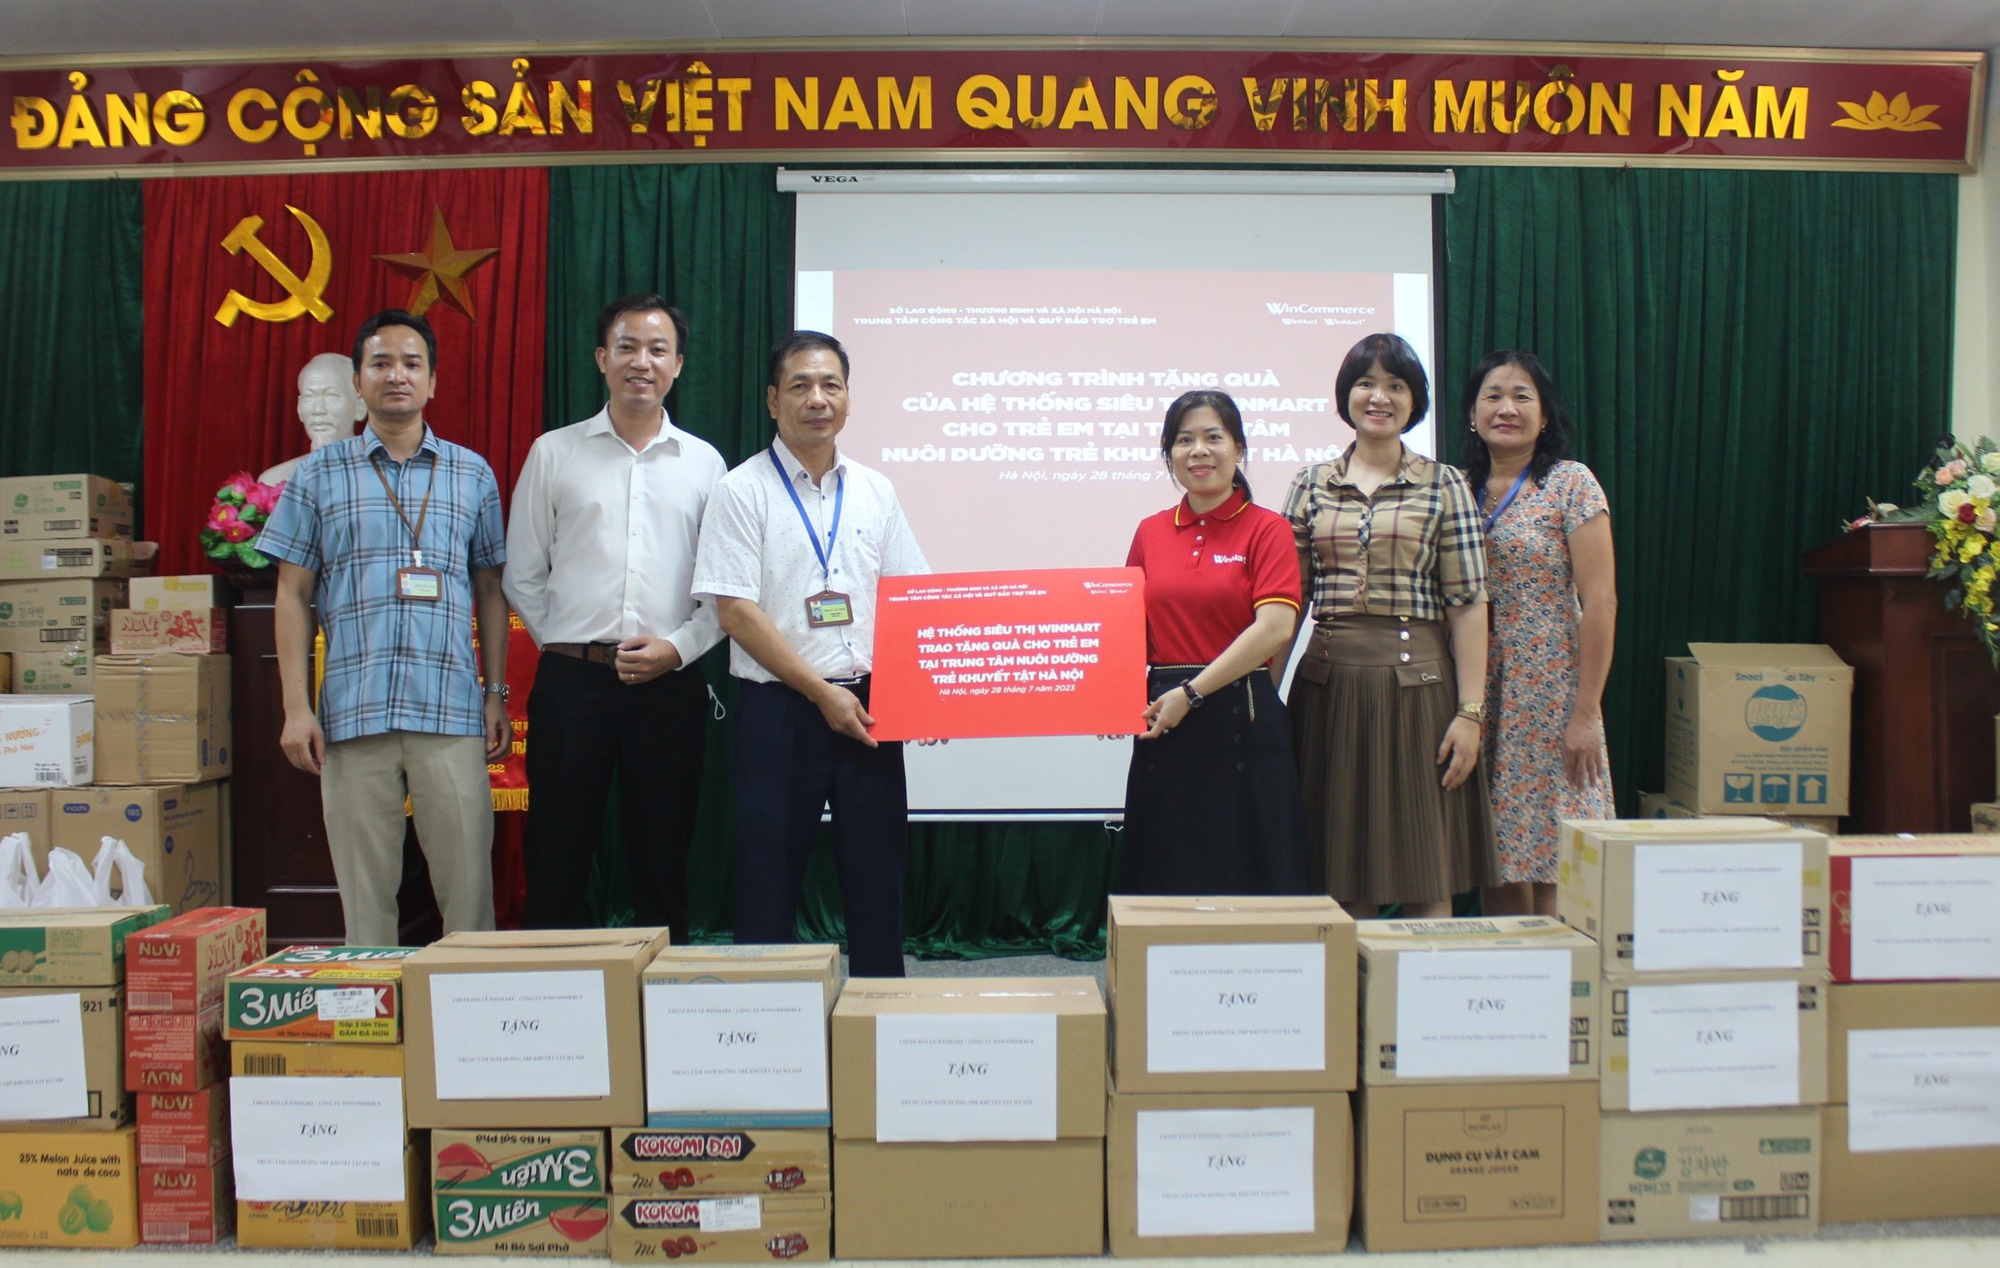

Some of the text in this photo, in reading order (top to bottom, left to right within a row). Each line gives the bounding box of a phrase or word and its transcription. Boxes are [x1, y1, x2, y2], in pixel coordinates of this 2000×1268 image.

[11, 58, 1809, 156] ĐẢNG CỘNG SẢN VIỆT NAM QUANG VINH MUÔN NĂM
[811, 175, 859, 184] VEGA
[1265, 302, 1376, 315] WinCommerce
[853, 317, 892, 325] TRUNG
[894, 315, 919, 325] TÂM
[920, 315, 953, 325] CÔNG
[1140, 317, 1157, 325] EM
[952, 368, 1280, 390] CHƯƠNG TRÌNH TẶNG QUÀ
[902, 391, 957, 412] CỦA
[962, 394, 997, 415] HỆ
[1001, 391, 1092, 412] THỐNG
[1096, 394, 1154, 412] SIÊU
[1233, 397, 1329, 413] INMART
[942, 421, 997, 437] CHO
[1003, 416, 1052, 437] TRẺ
[1057, 421, 1094, 437] EM
[1099, 421, 1139, 439] TẠI
[1242, 420, 1290, 437] TÂM
[882, 443, 945, 462] NUÔI
[951, 443, 1044, 462] DƯỠNG
[1049, 441, 1098, 462] TRẺ
[1262, 444, 1300, 462] HÀ
[999, 470, 1163, 483] Hà Nội, ngày 28 tháng 7
[917, 622, 1101, 640] HỆ THỐNG SIÊU THỊ WINMART
[918, 635, 1100, 654] TRAO TẶNG QUÀ CHO TRẺ EM
[918, 652, 1098, 671] TẠI TRUNG TÂM NUÔI DƯỠNG
[932, 668, 1084, 685] TRẺ KHUYẾT TẬT HÀ NỘI
[951, 687, 968, 697] Nội,
[969, 687, 990, 696] ngày
[991, 686, 1002, 694] 28
[1003, 685, 1027, 696] tháng
[1054, 684, 1076, 692] 2023
[83, 1001, 103, 1013] 921
[240, 986, 318, 1026] 3 Miề
[500, 1019, 540, 1034] TẶNG
[717, 1031, 757, 1046] TẶNG
[947, 1062, 988, 1078] TẶNG
[300, 1123, 338, 1138] TẶNG
[635, 1135, 741, 1159] KOKOMI ĐẠI
[1512, 1149, 1540, 1160] CAM
[19, 1153, 121, 1165] 25% Melon Juice with
[57, 1166, 120, 1177] nata de coco
[500, 1149, 594, 1188] 3 Miền
[448, 1198, 542, 1238] 3 Miền
[635, 1201, 700, 1224] KOKOM
